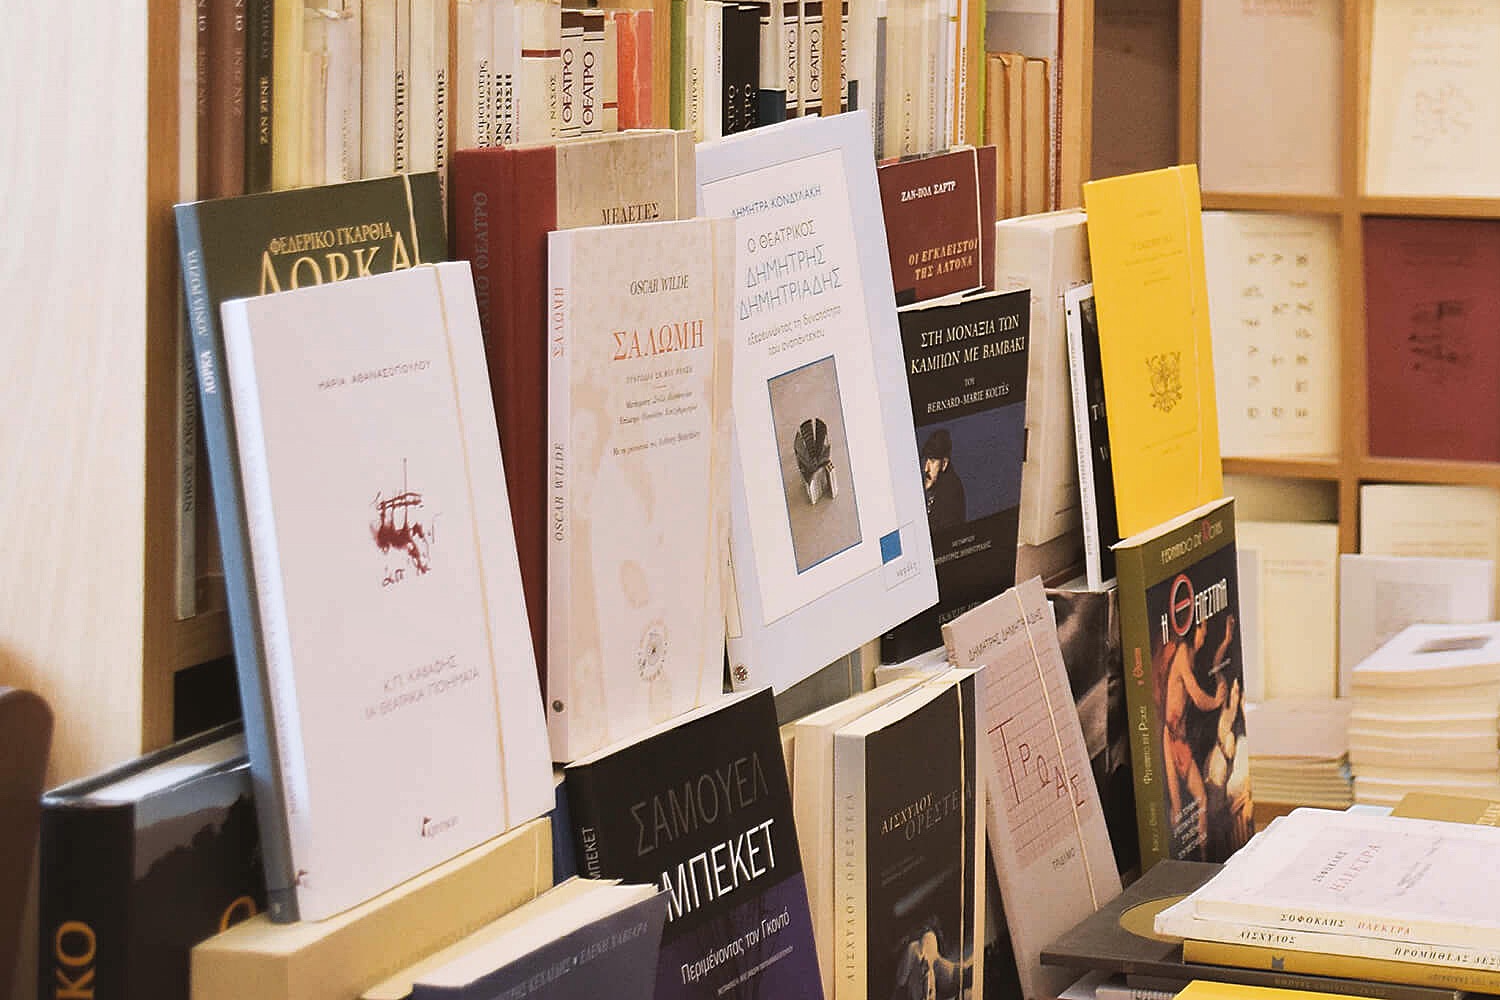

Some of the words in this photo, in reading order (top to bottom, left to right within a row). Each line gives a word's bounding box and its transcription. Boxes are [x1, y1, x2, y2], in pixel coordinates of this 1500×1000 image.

[787, 29, 796, 94] ΘΕΑΤΡΟ
[809, 29, 821, 93] ΘΕΑΤΡΟ
[260, 76, 270, 113] ΖΕΝΕ
[562, 47, 573, 124] ΘΕΑΤΡΟ
[583, 51, 595, 126] ΘΕΑΤΡΟ
[260, 116, 270, 145] ΖΑΝ
[900, 182, 933, 202] ΖΑΝ-ΠΟΛ
[933, 179, 956, 197] ΣΑΡΤΡ
[473, 191, 489, 270] ΘΕΑΤΡΟ
[600, 201, 660, 226] ΜΕΛΕΤΕΣ
[269, 230, 335, 256] ΦΕΔΕΡΙΚΟ
[337, 221, 393, 245] ΓΚΑΡΘΙΑ
[747, 237, 756, 253] Ο
[759, 219, 817, 250] ΘΕΑΤΡΙΚΟΣ
[908, 251, 919, 267] ΟΙ
[921, 238, 979, 265] ΕΓΚΛΕΙΣΤΟΙ
[260, 230, 411, 296] ΛΟΡΚΑ
[630, 276, 660, 296] OSCAR
[661, 272, 690, 292] WILDE
[743, 243, 826, 288] ΔΗΜΗΤΡΗΣ
[914, 264, 934, 281] ΤΗΣ
[936, 256, 974, 277] ΑΛΤΟΝΑ
[737, 267, 843, 321] ΔΗΜΗΤΡΙΑΔΗΣ
[552, 286, 567, 359] ΣΑΛΩΜΗ
[612, 319, 705, 361] ΣΑΛΩΜΗ
[920, 327, 943, 348] ΣΤΗ
[946, 318, 995, 344] ΜΟΝΑΞΙΑ
[997, 314, 1020, 334] ΤΩΝ
[199, 349, 217, 395] ΛΟΡΚΑ
[911, 350, 961, 374] ΚΑΜΠΩΝ
[963, 346, 980, 362] ΜΕ
[982, 336, 1025, 361] ΒΑΜΒΑΚΙ
[927, 388, 983, 414] BERNARD-MARIE
[553, 442, 568, 490] WILDE
[553, 498, 568, 543] OSCAR
[1161, 612, 1169, 646] Η
[629, 750, 769, 857] ΣΑΜΟΥΕΛ
[582, 825, 601, 881] ΜΠΕΚΕΤ
[661, 818, 777, 922] ΜΠΕΚΕΤ
[680, 932, 745, 985] Περιμένοντας
[744, 927, 761, 948] τον
[761, 905, 791, 941] Γκοντό
[1239, 931, 1297, 945] ΑΙΣΧΥΛΟΣ
[1280, 912, 1346, 929] ΣΟΦΟΚΛΗΣ
[1356, 920, 1413, 937] ΗΛΕΚΤΡΑ
[1394, 946, 1469, 964] ΠΡΟΜΗΘΕΑΣ
